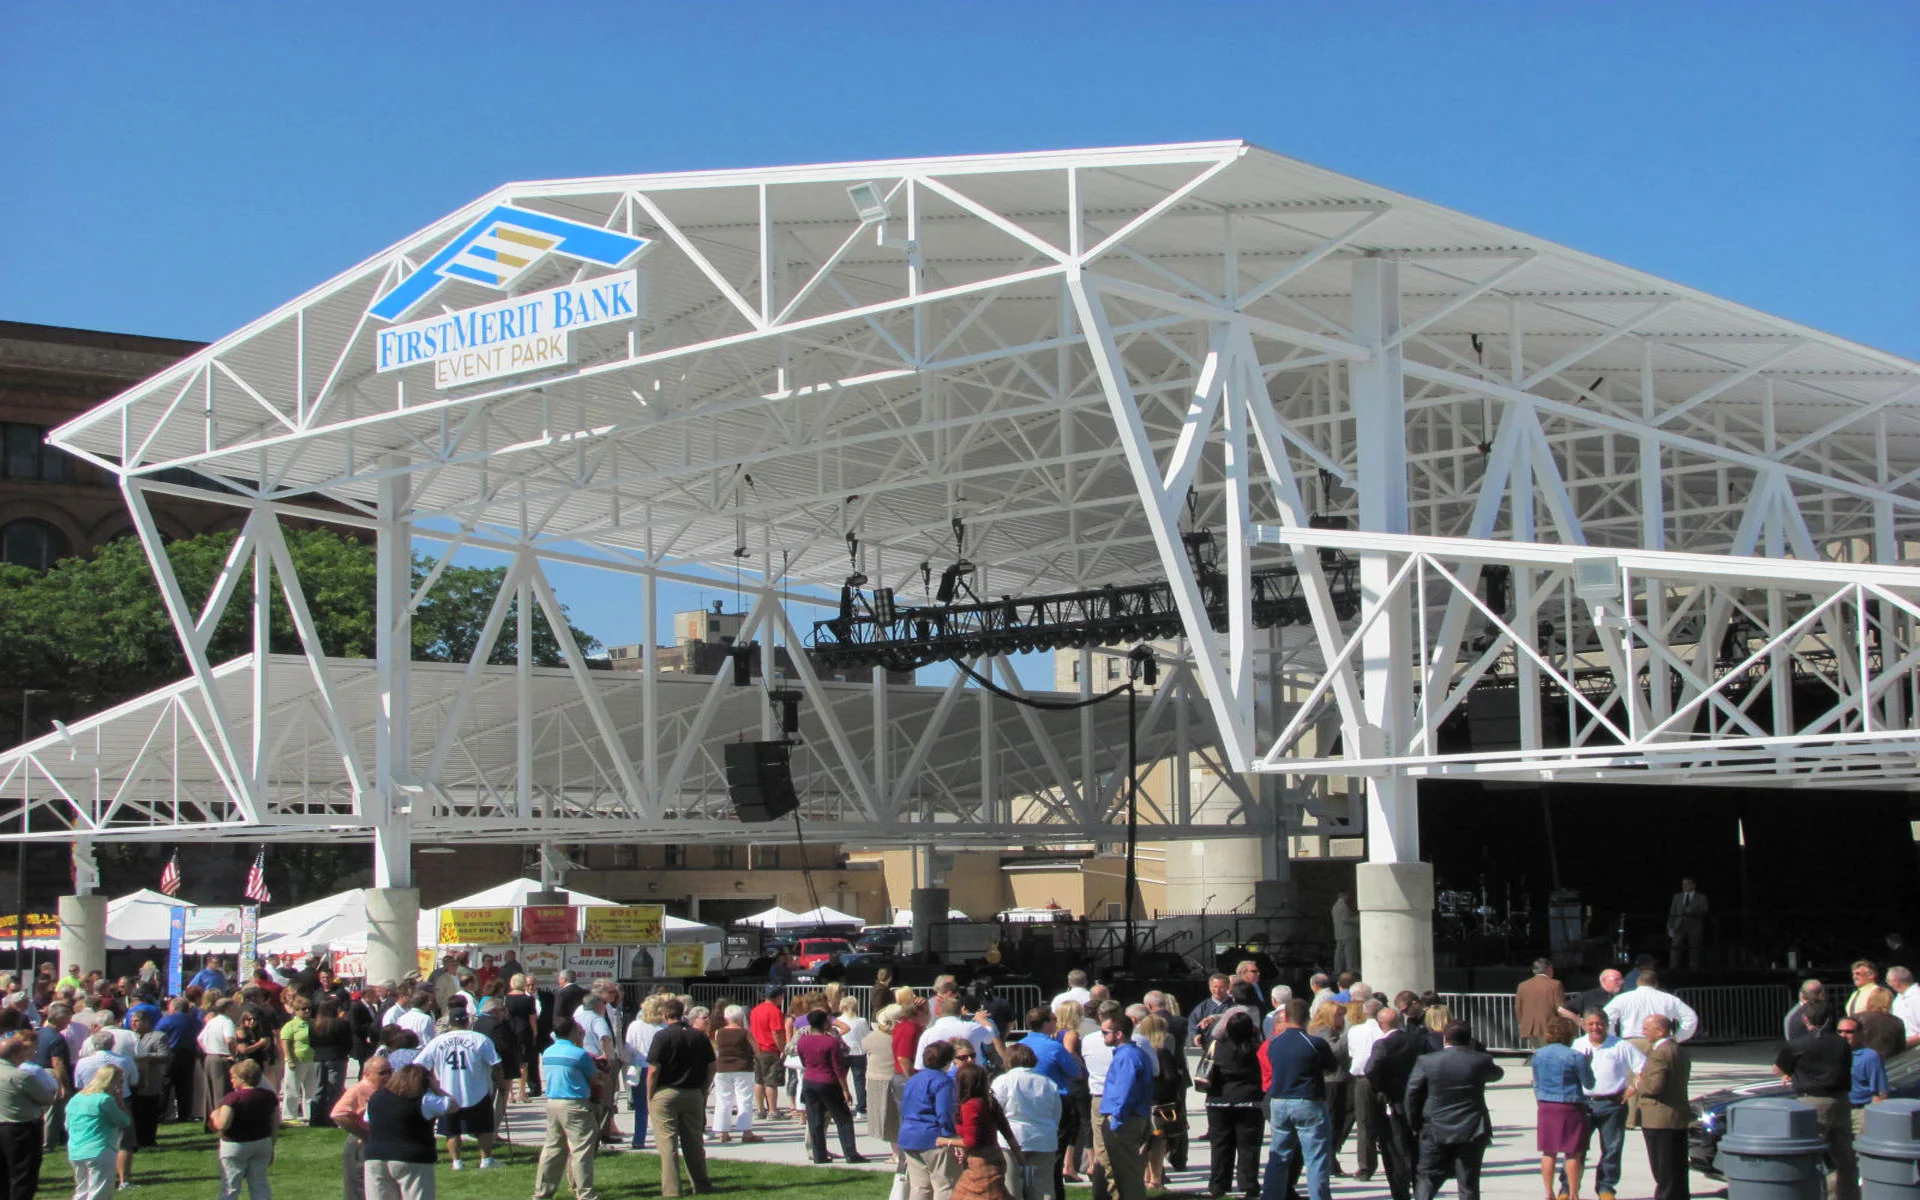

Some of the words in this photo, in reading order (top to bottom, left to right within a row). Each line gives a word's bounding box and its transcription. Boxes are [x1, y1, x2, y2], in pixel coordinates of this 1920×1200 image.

[552, 280, 633, 330] BANK
[438, 346, 505, 383] EVENT
[511, 334, 564, 368] PARK
[569, 955, 616, 968] Catering
[446, 1050, 467, 1070] 41
